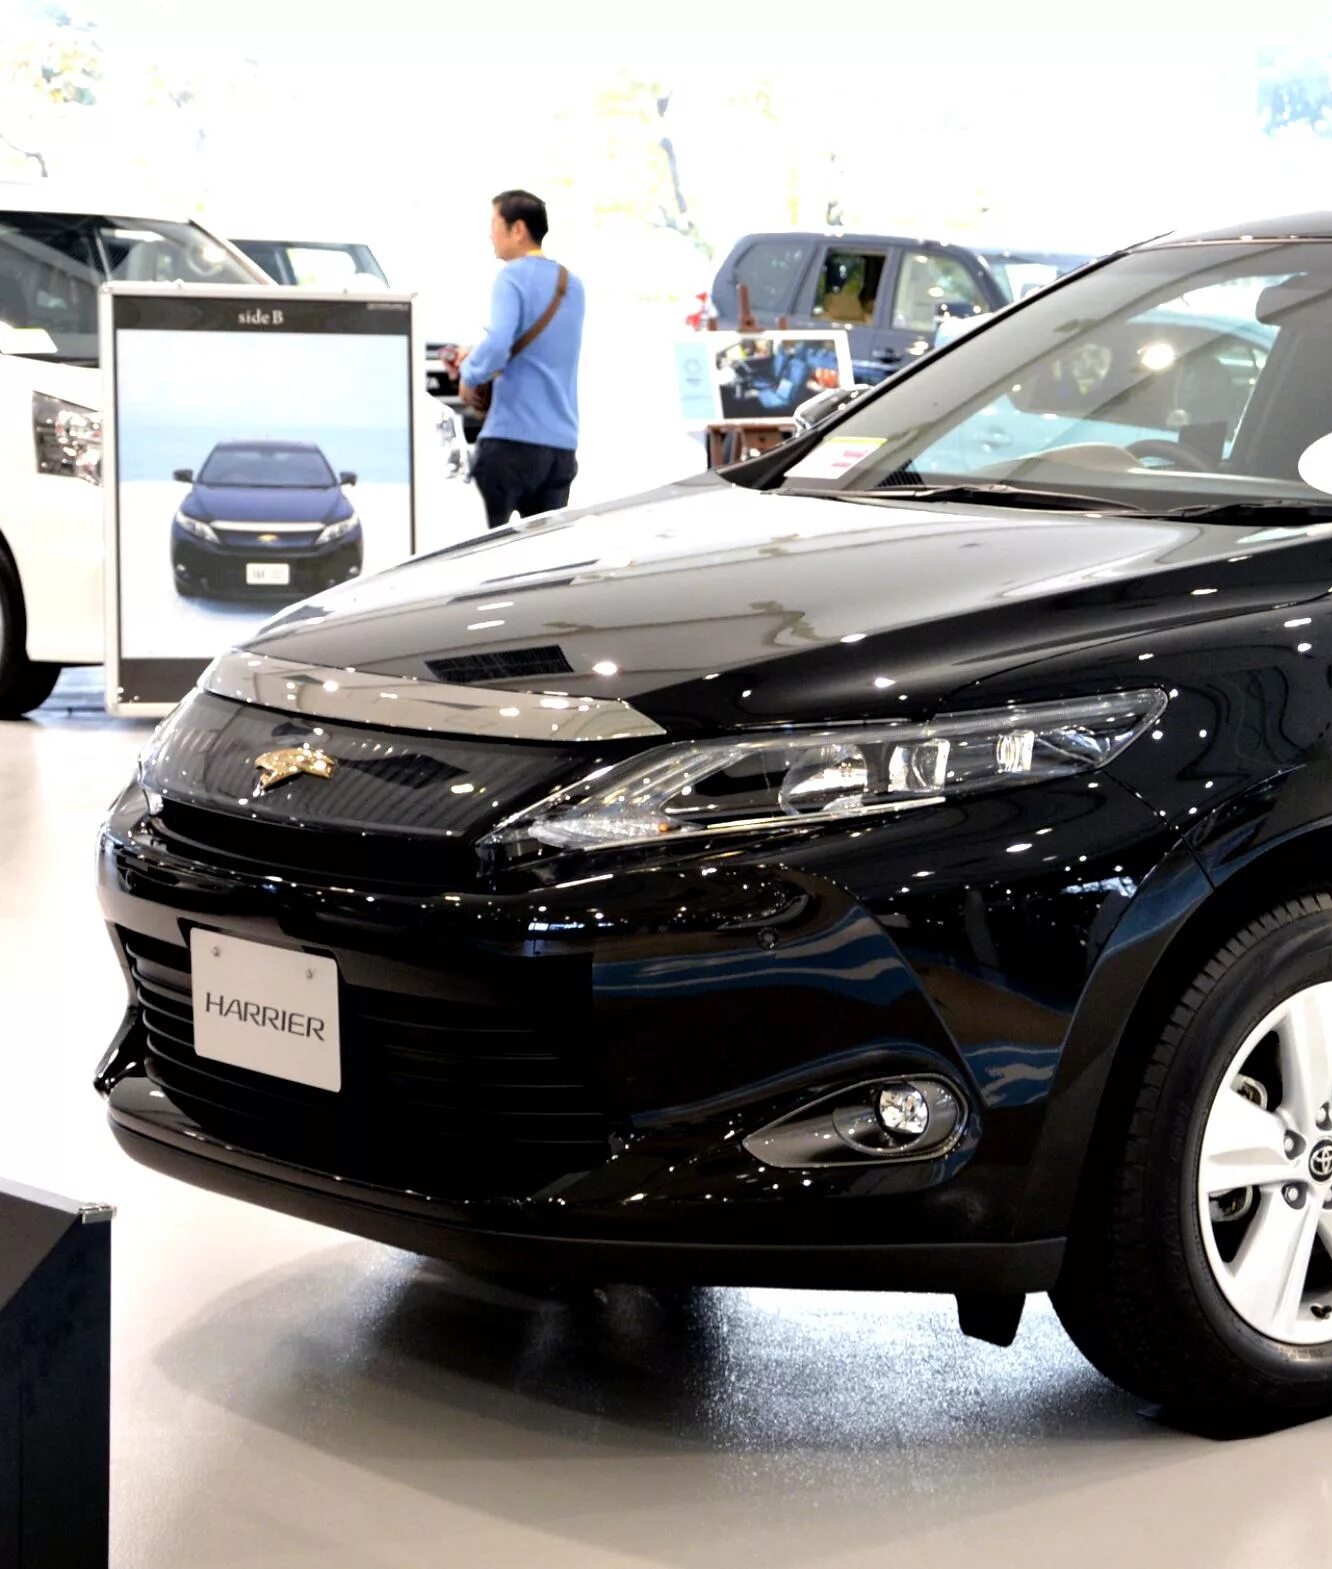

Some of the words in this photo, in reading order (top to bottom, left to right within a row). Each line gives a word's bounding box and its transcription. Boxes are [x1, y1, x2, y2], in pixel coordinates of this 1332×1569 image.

[237, 308, 269, 325] side
[271, 309, 285, 325] B
[205, 991, 326, 1042] HARRIER
